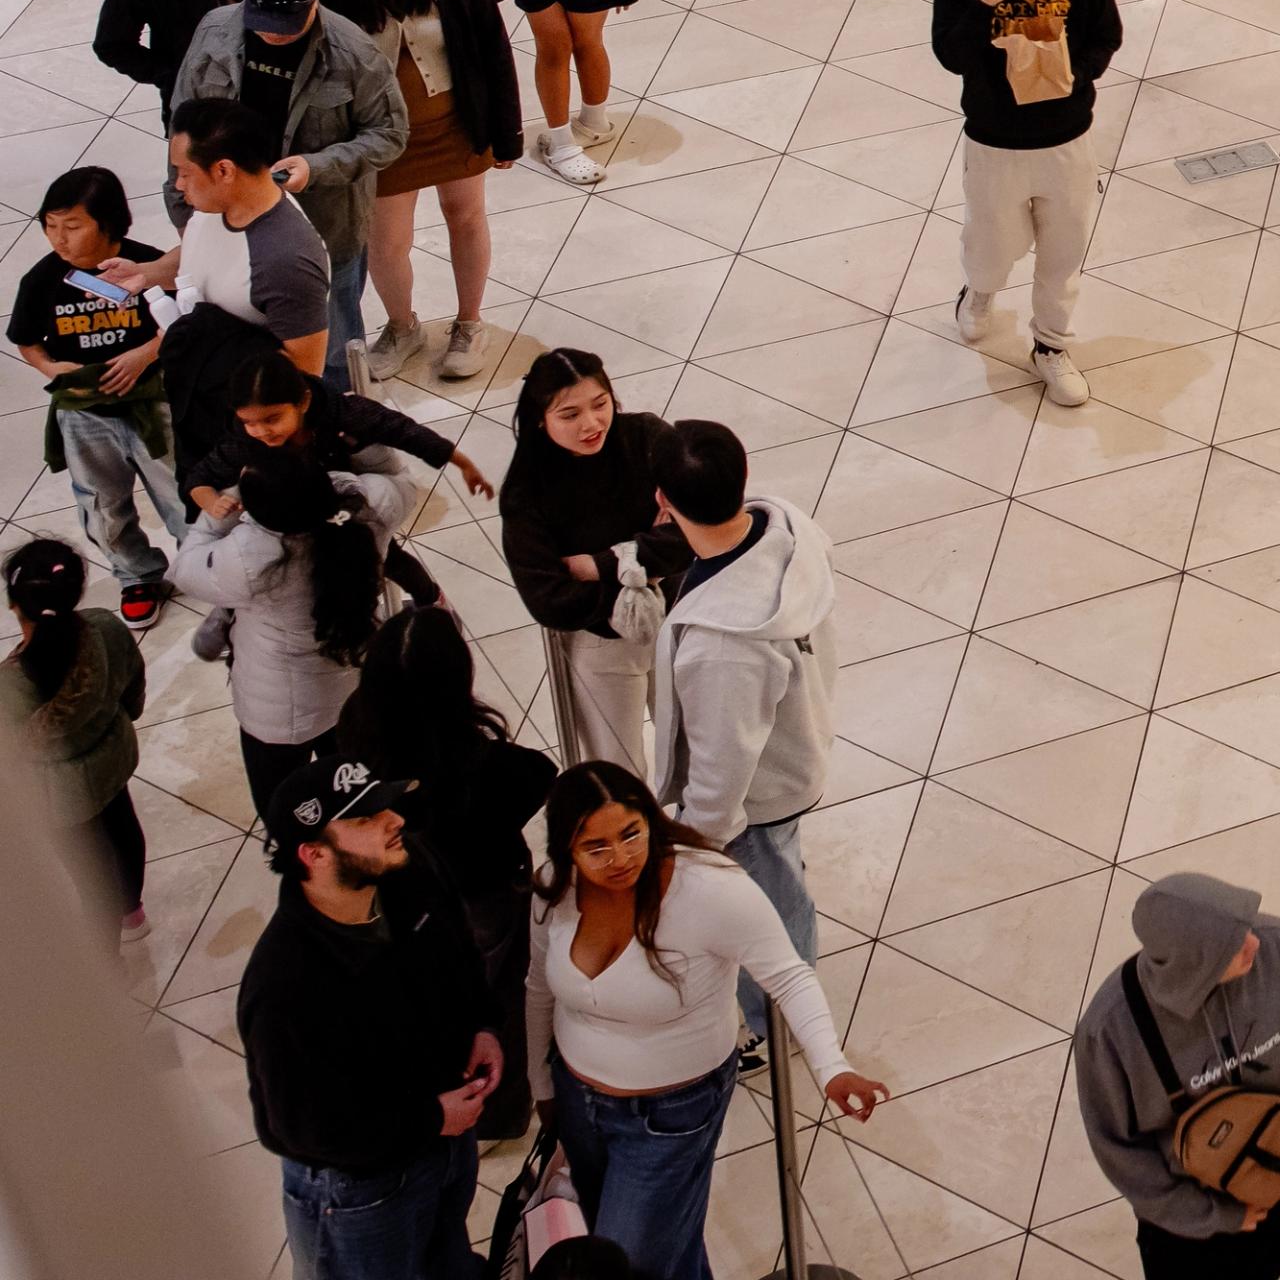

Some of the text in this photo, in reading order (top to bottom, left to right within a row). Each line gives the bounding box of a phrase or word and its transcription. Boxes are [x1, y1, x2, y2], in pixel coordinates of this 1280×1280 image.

[247, 60, 297, 80] AKLE
[56, 304, 75, 316] DO
[77, 299, 105, 313] YOU
[56, 309, 142, 336] BRAWL
[79, 329, 126, 349] BRO?
